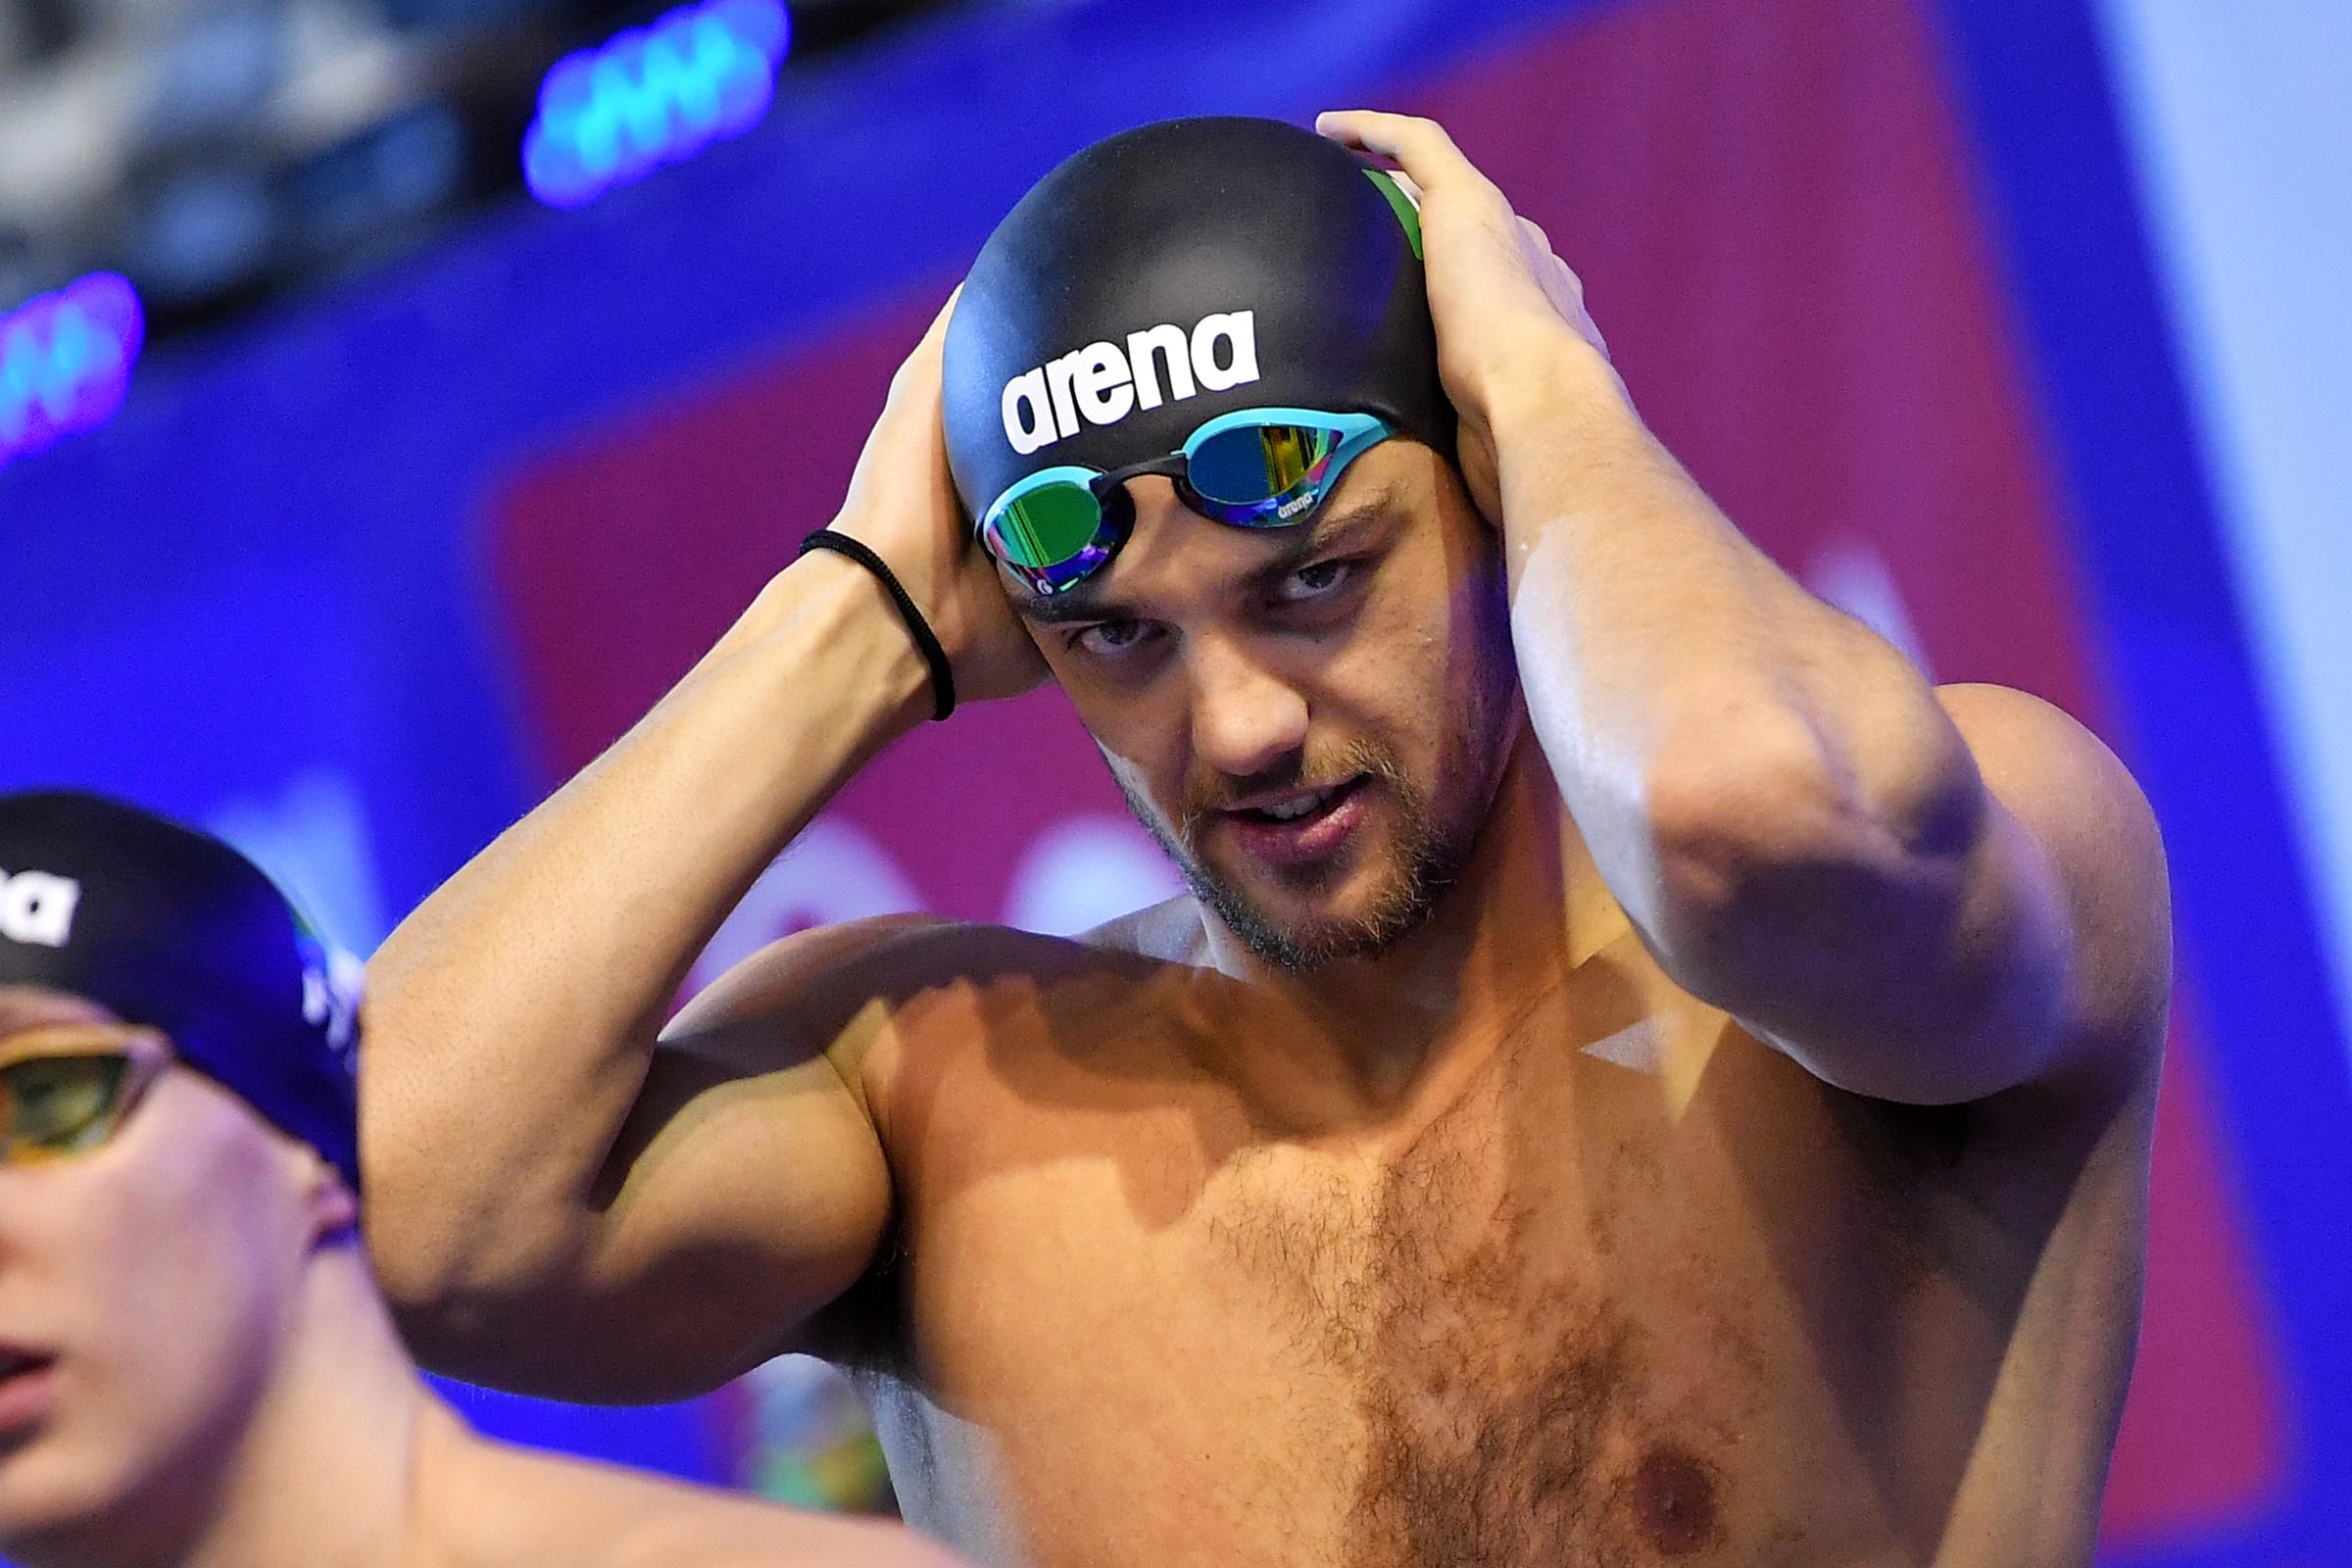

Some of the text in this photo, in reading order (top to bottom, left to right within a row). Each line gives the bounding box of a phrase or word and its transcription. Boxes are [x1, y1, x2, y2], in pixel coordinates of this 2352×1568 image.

[1002, 310, 1260, 455] arena
[1278, 491, 1313, 519] arena
[0, 866, 80, 948] a
